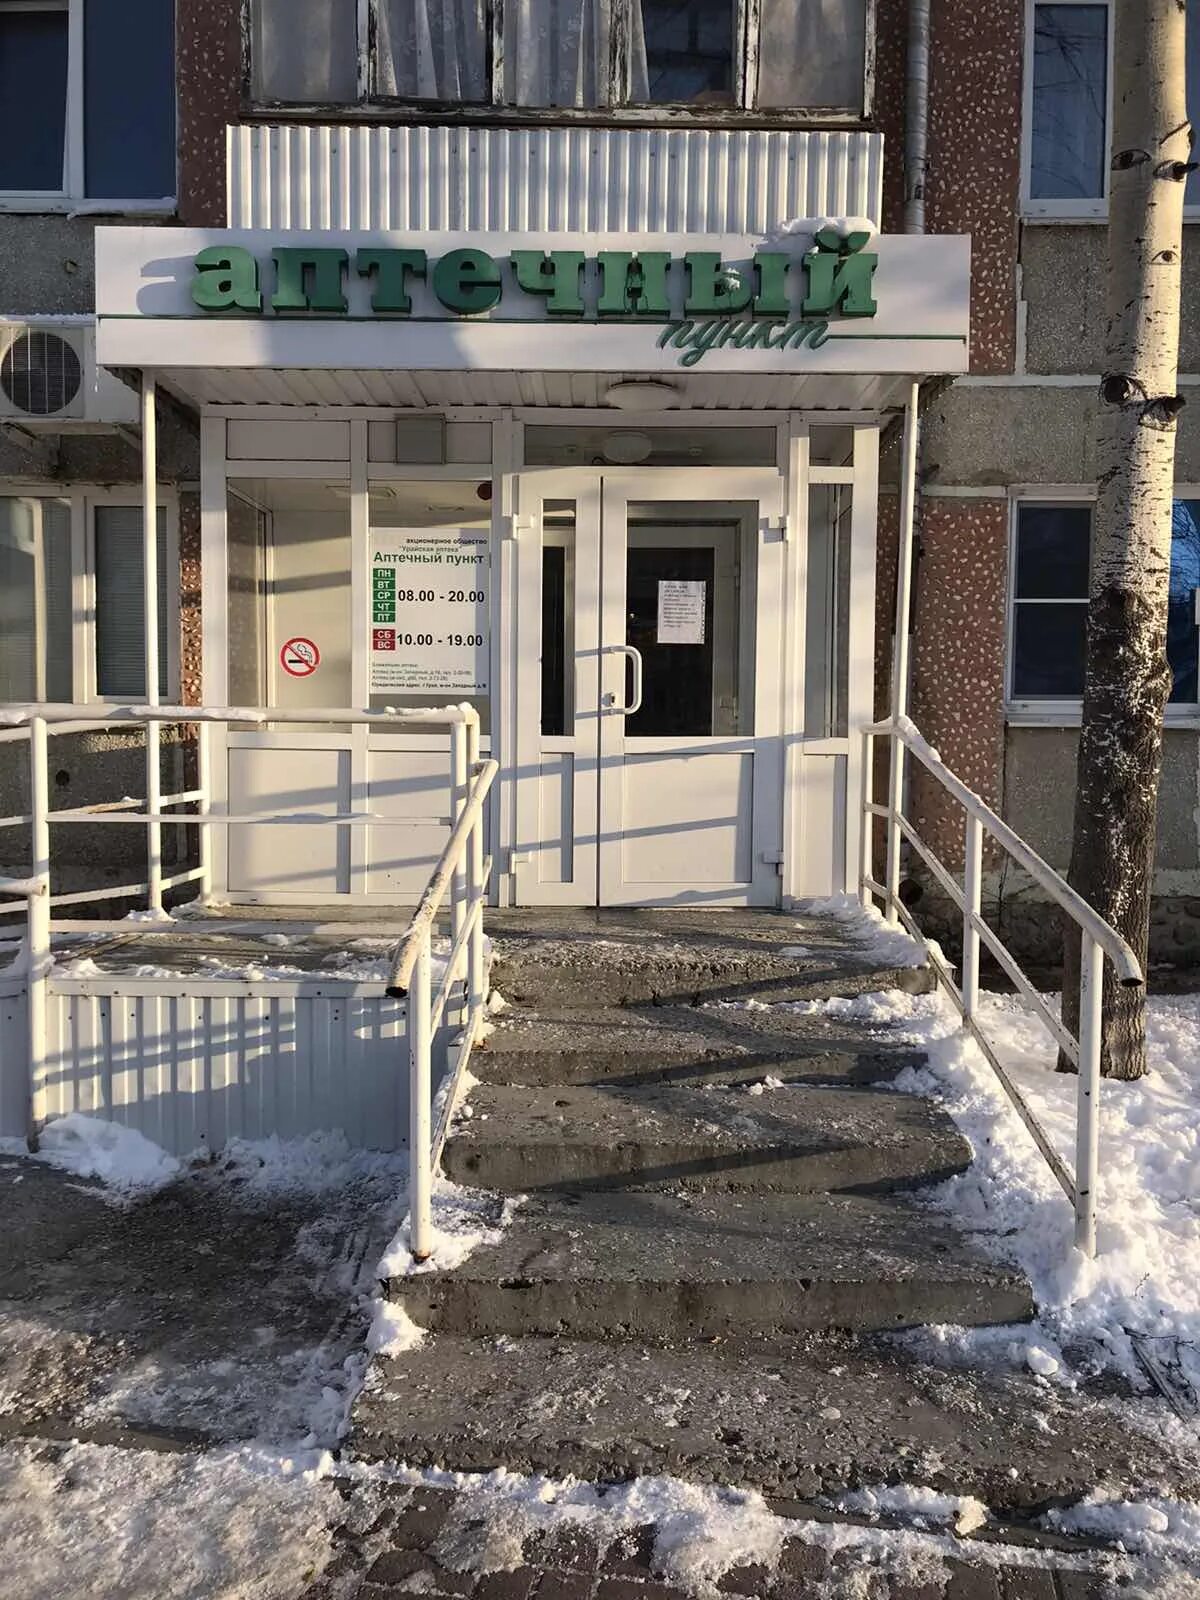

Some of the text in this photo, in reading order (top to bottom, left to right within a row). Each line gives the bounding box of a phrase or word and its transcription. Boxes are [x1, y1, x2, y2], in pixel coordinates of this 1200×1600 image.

[189, 231, 879, 318] аптечный
[656, 319, 829, 367] пункт
[373, 551, 484, 566] Аптечный пункт
[398, 590, 435, 602] 08.00
[448, 591, 485, 602] 20.00
[377, 641, 391, 649] ВС
[397, 634, 433, 646] 10.00
[448, 634, 483, 646] 19.00
